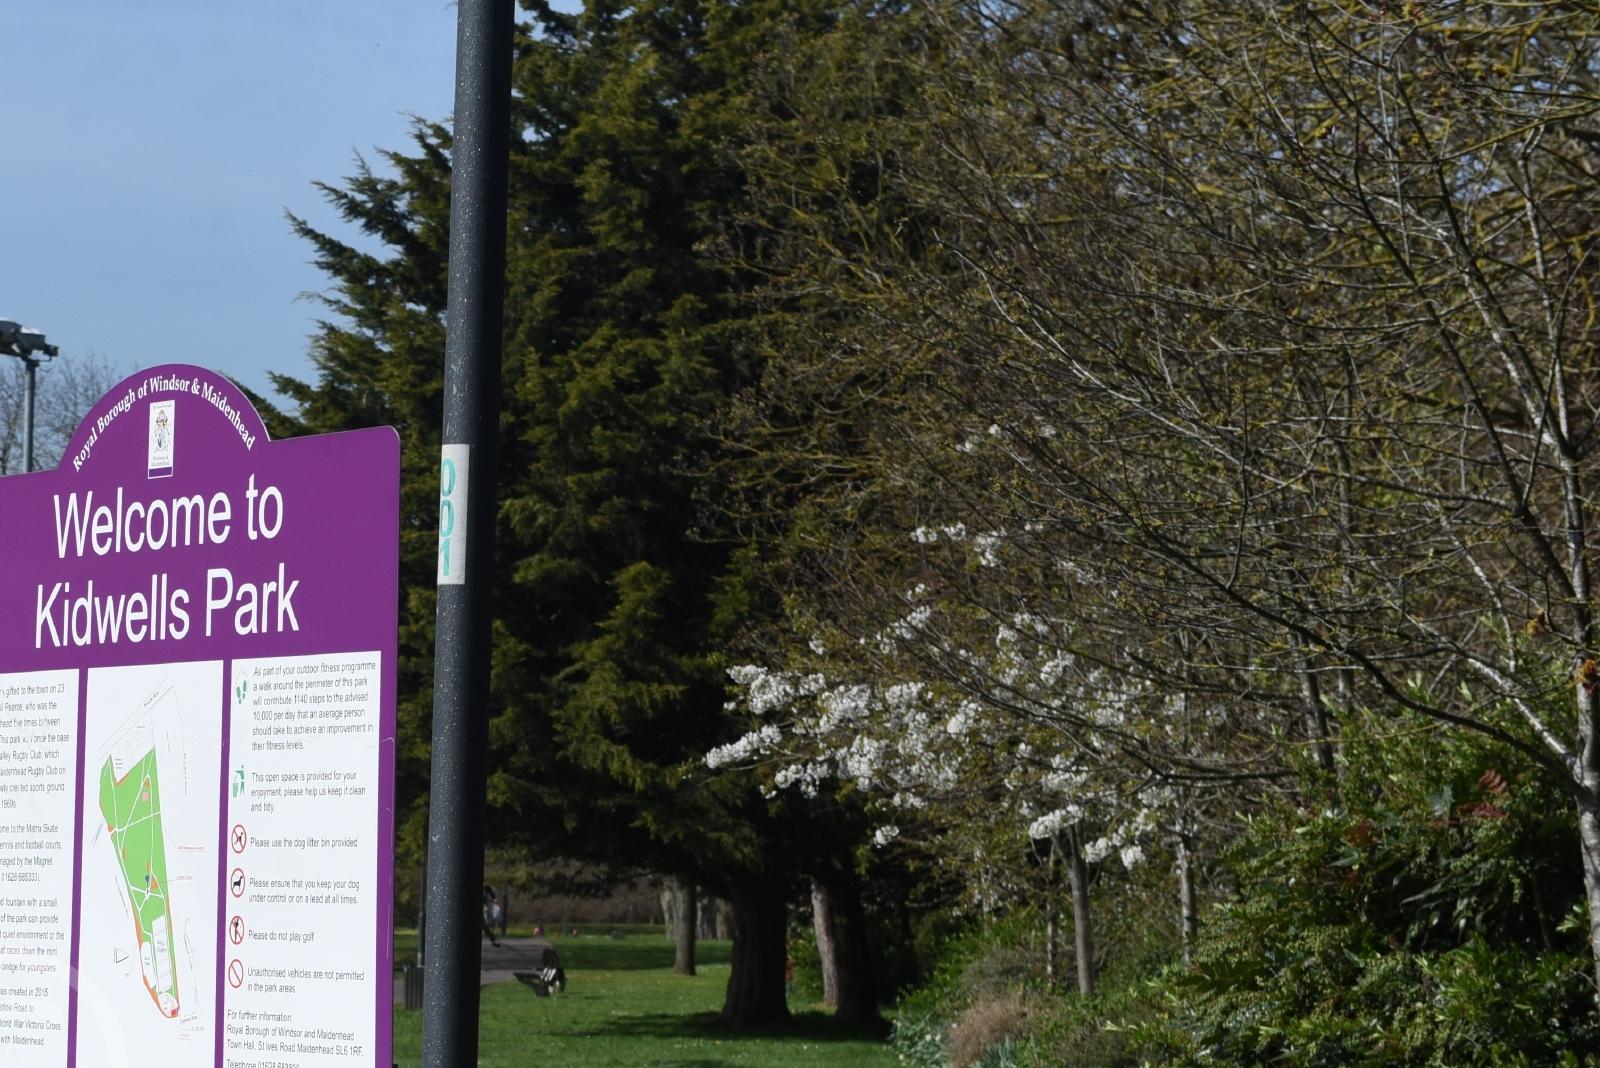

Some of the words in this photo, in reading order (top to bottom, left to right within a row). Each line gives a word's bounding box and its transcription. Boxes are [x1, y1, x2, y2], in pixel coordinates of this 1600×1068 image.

[73, 428, 98, 472] Royal
[97, 389, 136, 434] Borough
[138, 380, 148, 399] of
[150, 374, 190, 394] Windsor
[191, 377, 201, 395] &
[202, 382, 256, 451] Maidenhead
[54, 487, 232, 558] Welcome
[245, 473, 283, 540] to
[35, 573, 190, 648] Kidwells
[205, 562, 300, 637] Park
[254, 667, 261, 677] As
[263, 666, 274, 679] part
[276, 666, 281, 676] of
[283, 667, 295, 678] your
[297, 664, 319, 675] outdoor
[321, 663, 340, 673] fitness
[342, 663, 376, 675] programme
[259, 681, 271, 691] walk
[273, 680, 293, 690] around
[295, 679, 303, 689] the
[335, 677, 341, 687] of
[342, 677, 353, 687] this
[355, 676, 367, 689] park
[253, 696, 262, 706] will
[264, 695, 292, 705] contribute
[294, 694, 308, 704] 1140
[309, 693, 325, 706] steps
[327, 693, 332, 703] to
[334, 692, 343, 702] the
[345, 692, 368, 702] advised
[254, 710, 272, 722] 10,000
[274, 712, 283, 723] per
[285, 709, 295, 722] day
[298, 709, 308, 719] that
[310, 711, 317, 719] an
[319, 710, 342, 721] average
[344, 710, 365, 720] person
[253, 725, 271, 735] should
[273, 725, 285, 735] take
[287, 725, 292, 734] to
[294, 724, 316, 734] achieve
[318, 726, 325, 734] an
[327, 723, 367, 736] improvement
[368, 722, 373, 732] in
[252, 740, 265, 750] their
[267, 740, 285, 750] fitness
[28, 766, 44, 778] Rugby
[46, 766, 58, 775] Club
[252, 772, 264, 782] This
[265, 774, 280, 784] open
[281, 773, 299, 784] space
[307, 770, 332, 783] provided
[334, 770, 342, 780] for
[343, 772, 356, 782] your
[284, 786, 303, 799] please
[305, 786, 317, 798] help
[328, 785, 342, 798] keep
[344, 785, 348, 795] it
[350, 785, 366, 795] clean
[251, 802, 262, 811] and
[11, 824, 16, 833] to
[17, 824, 25, 833] the
[43, 824, 59, 833] Skate
[250, 837, 270, 847] Please
[284, 837, 292, 847] the
[294, 837, 305, 850] dog
[307, 837, 319, 847] litter
[321, 837, 330, 847] bin
[332, 837, 357, 850] provided
[250, 878, 269, 888] Please
[271, 880, 290, 888] ensure
[292, 878, 303, 888] that
[305, 881, 315, 891] you
[317, 878, 331, 891] keep
[333, 881, 346, 891] your
[348, 879, 359, 891] dog
[249, 892, 265, 902] under
[267, 893, 287, 903] control
[289, 895, 294, 903] or
[310, 893, 323, 903] lead
[325, 894, 330, 903] at
[249, 930, 268, 940] Please
[269, 931, 277, 941] do
[279, 931, 288, 941] not
[289, 931, 301, 944] play
[303, 931, 315, 944] golf
[248, 968, 286, 978] Unauthorised
[288, 969, 311, 979] vehicles
[325, 969, 334, 979] not
[336, 970, 365, 983] permitted
[9, 986, 27, 996] created
[29, 987, 34, 996] in
[35, 987, 48, 996] 2015
[248, 982, 252, 991] in
[254, 982, 263, 992] the
[265, 982, 277, 995] park
[279, 985, 295, 993] areas
[228, 1009, 237, 1019] For
[239, 1010, 257, 1020] further
[227, 1024, 243, 1038] Royal
[246, 1026, 270, 1039] Borough
[271, 1027, 277, 1037] of
[278, 1027, 301, 1038] Windsor
[304, 1028, 315, 1039] and
[317, 1030, 354, 1041] Maidenhead
[227, 1039, 242, 1050] Town
[266, 1041, 278, 1052] Ives
[280, 1042, 295, 1053] Road
[297, 1043, 334, 1055] Maidenhead
[336, 1045, 348, 1055] SL6
